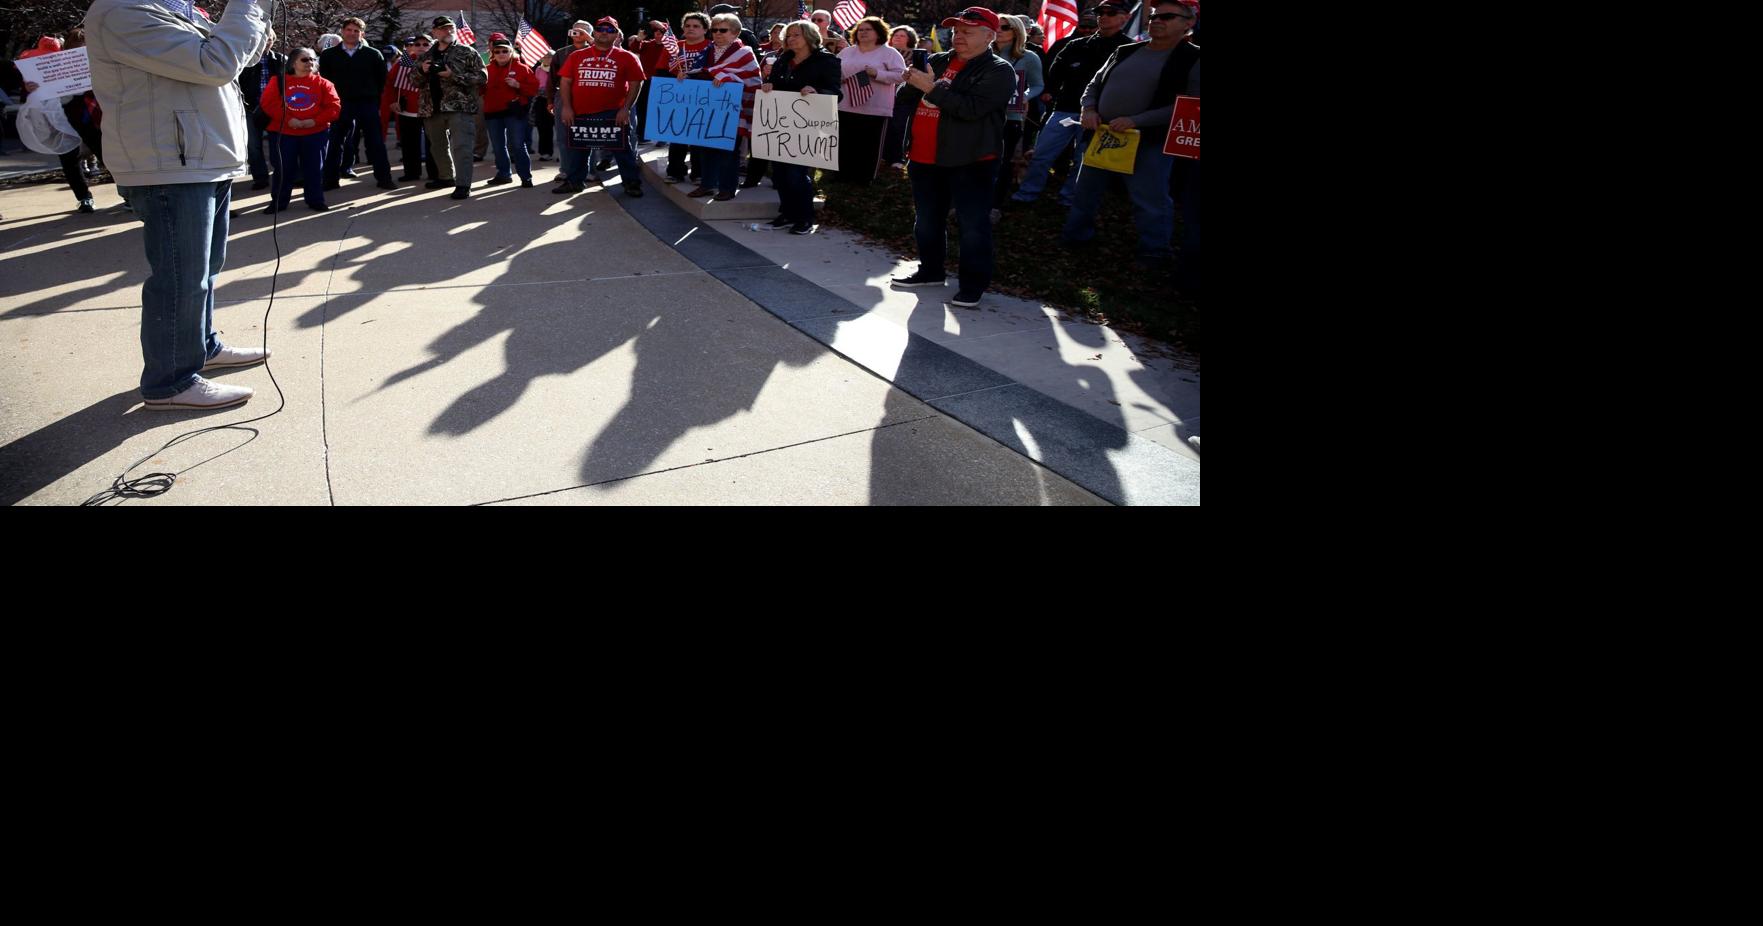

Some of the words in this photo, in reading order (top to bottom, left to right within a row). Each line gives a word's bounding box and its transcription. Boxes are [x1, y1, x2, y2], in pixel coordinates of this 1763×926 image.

[578, 70, 616, 80] TRUMP
[657, 82, 710, 106] Build
[713, 90, 740, 113] the
[570, 126, 621, 134] TRUMP
[656, 106, 736, 139] WALL
[760, 98, 790, 130] We
[792, 98, 839, 131] Support
[757, 130, 838, 162] TRUMP
